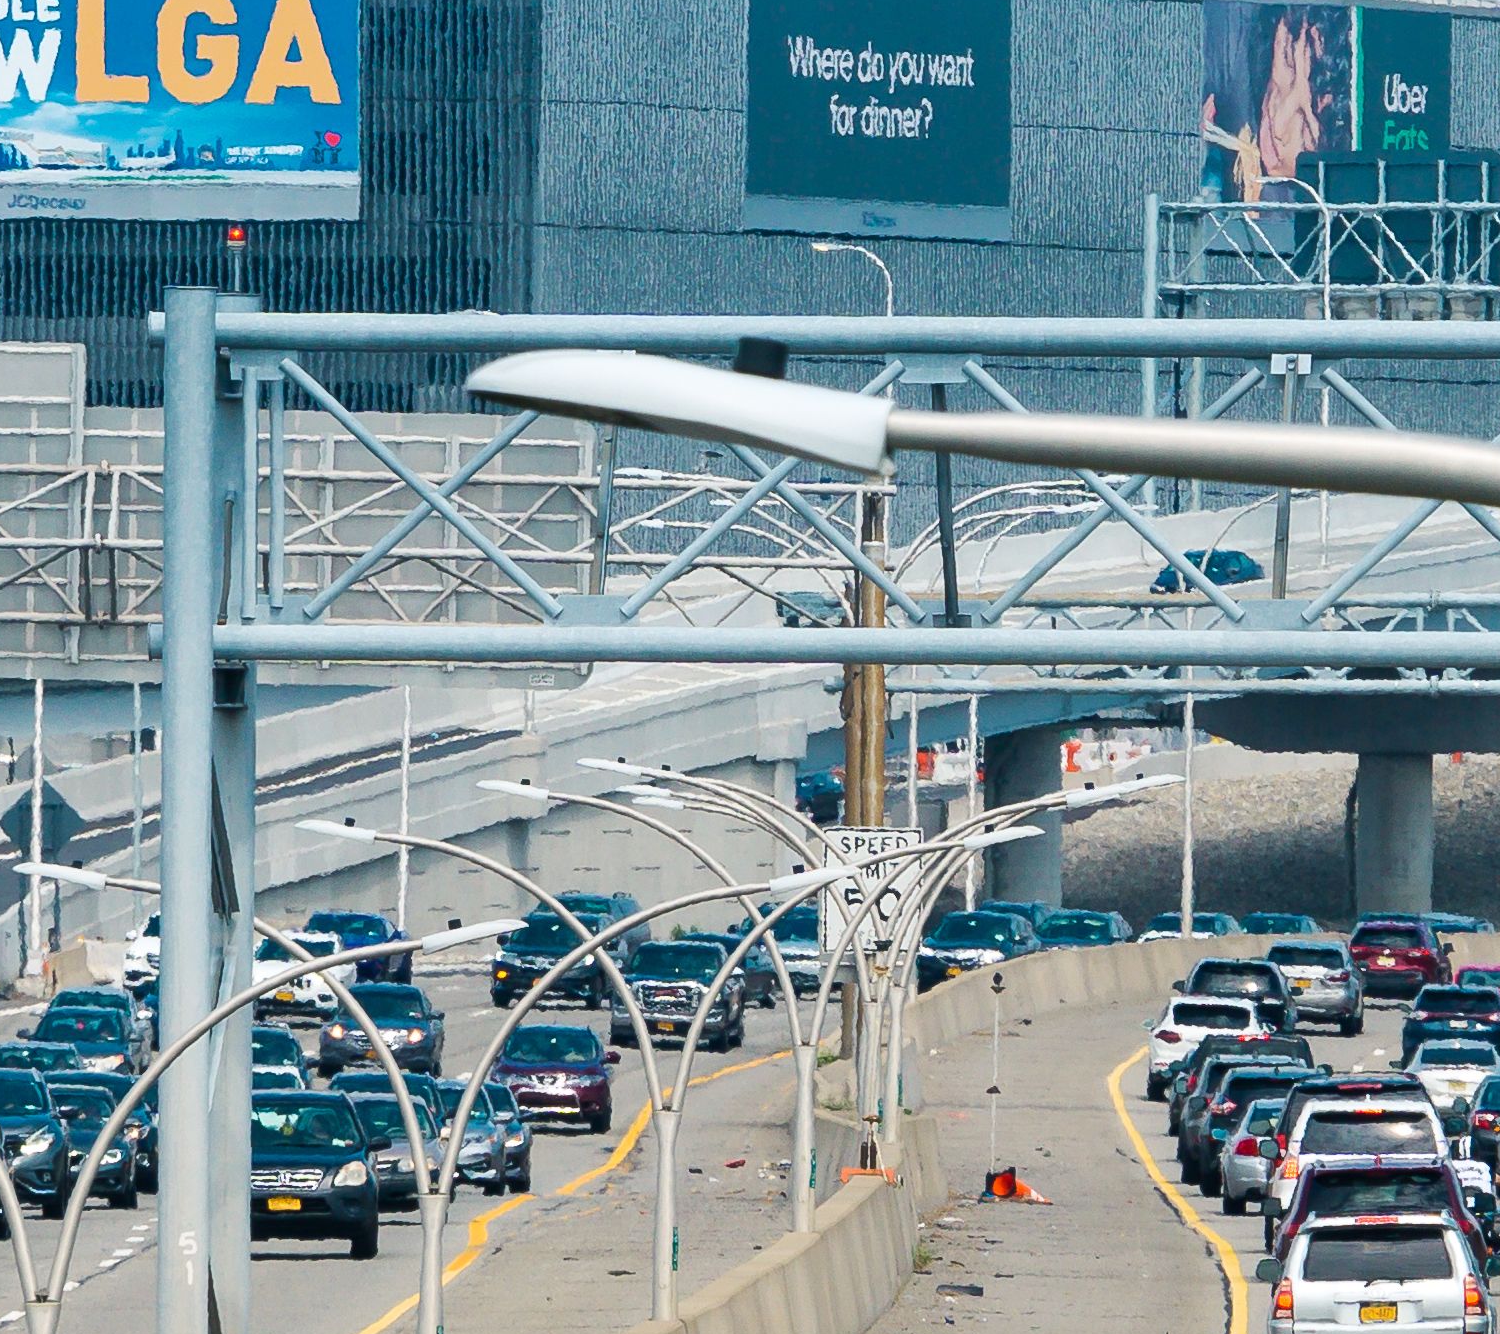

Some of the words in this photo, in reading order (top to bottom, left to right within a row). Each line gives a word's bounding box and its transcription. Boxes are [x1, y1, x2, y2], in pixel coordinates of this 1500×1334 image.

[787, 35, 854, 83] Where
[857, 41, 885, 83] do
[889, 51, 924, 94] you
[927, 49, 975, 87] want
[1383, 73, 1430, 115] Uber
[830, 94, 857, 137] for
[860, 96, 933, 139] dinner?
[1383, 120, 1430, 151] Eats
[840, 837, 908, 855] SPEED
